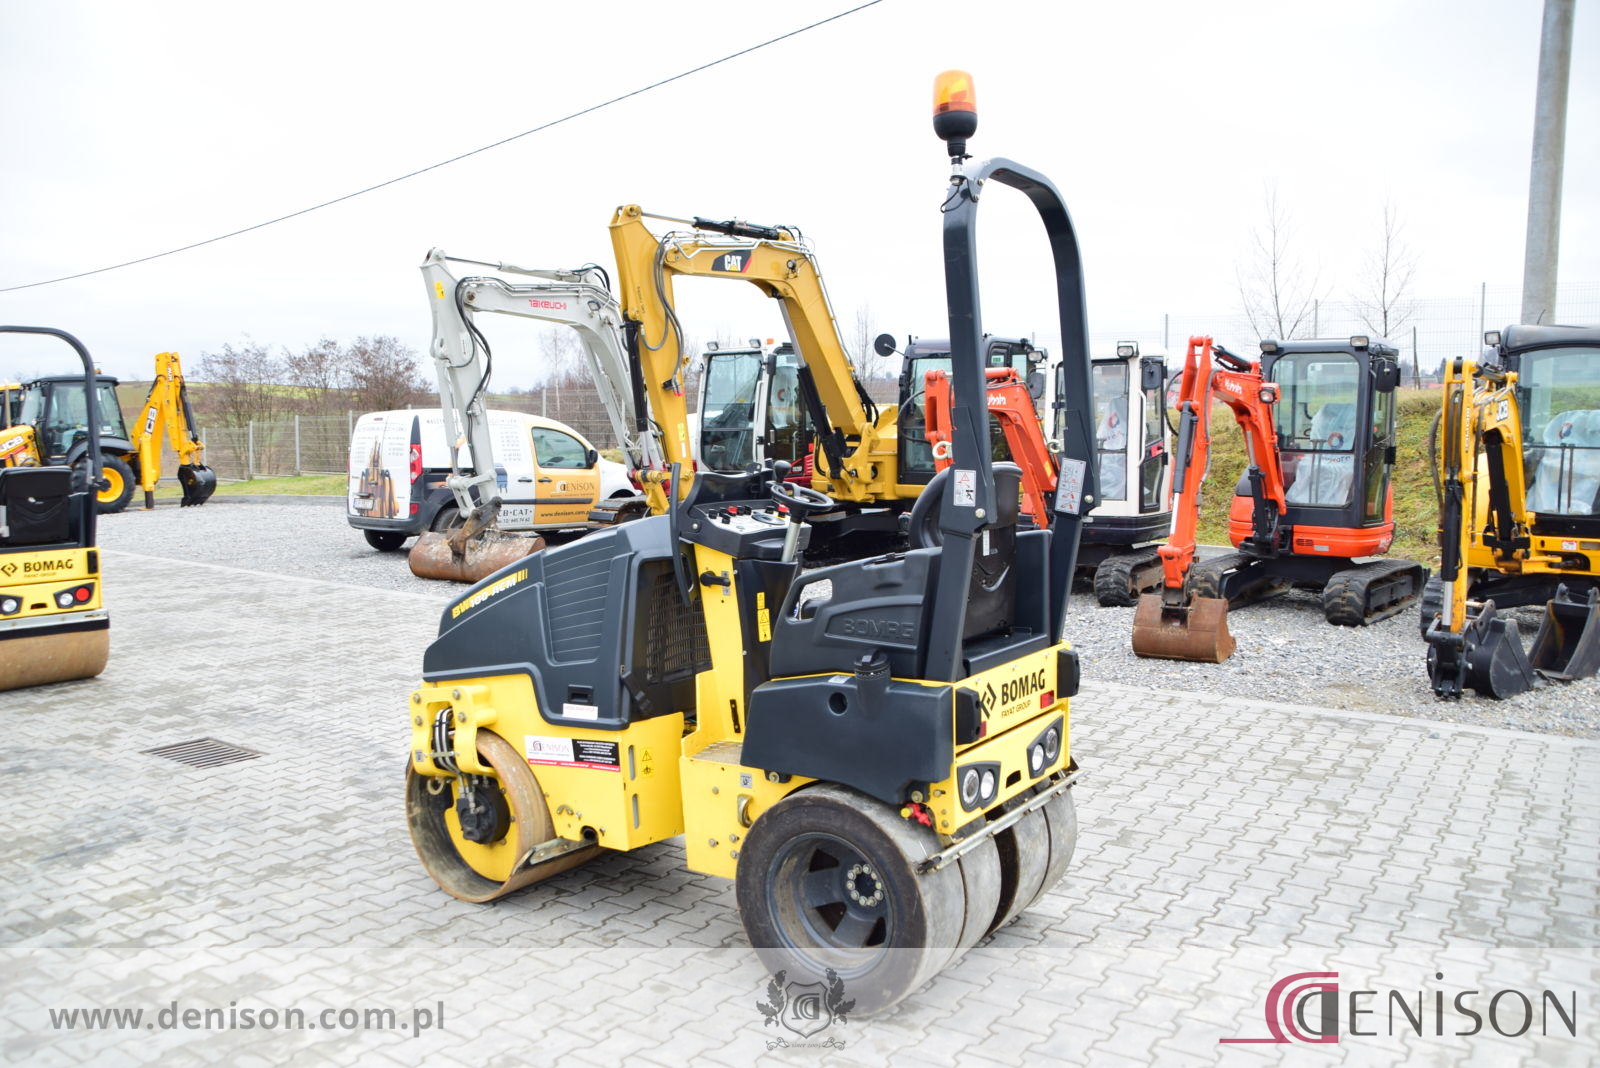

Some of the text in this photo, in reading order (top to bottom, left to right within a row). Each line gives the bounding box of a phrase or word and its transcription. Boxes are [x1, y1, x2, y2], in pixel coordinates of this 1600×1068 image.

[724, 254, 742, 272] CAT
[23, 558, 74, 573] BOMAG
[1001, 668, 1046, 706] BOMAG
[1016, 699, 1031, 712] GROUP
